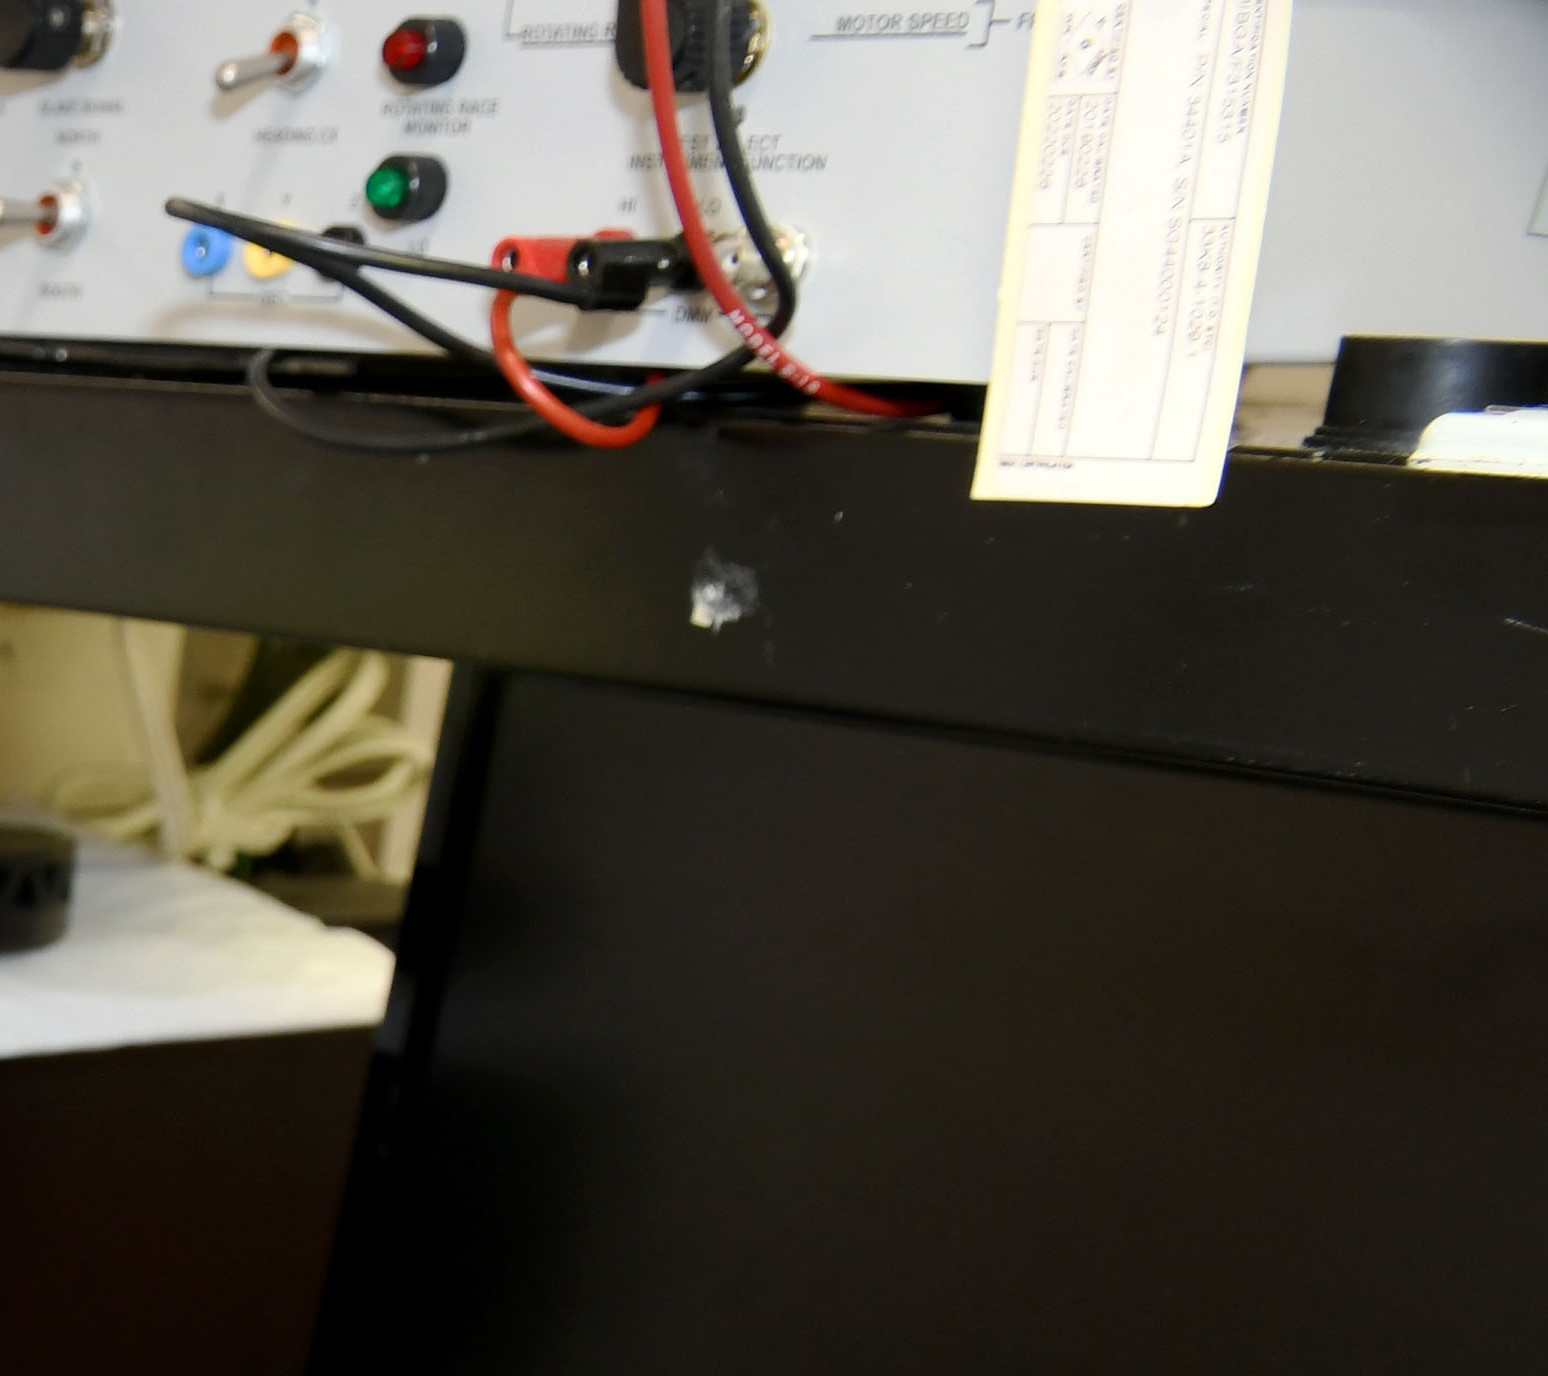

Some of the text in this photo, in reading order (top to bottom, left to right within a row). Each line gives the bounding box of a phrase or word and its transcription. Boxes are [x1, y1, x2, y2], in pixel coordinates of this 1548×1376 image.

[836, 11, 970, 32] MOTOR SPEED
[749, 153, 829, 171] UNCTION
